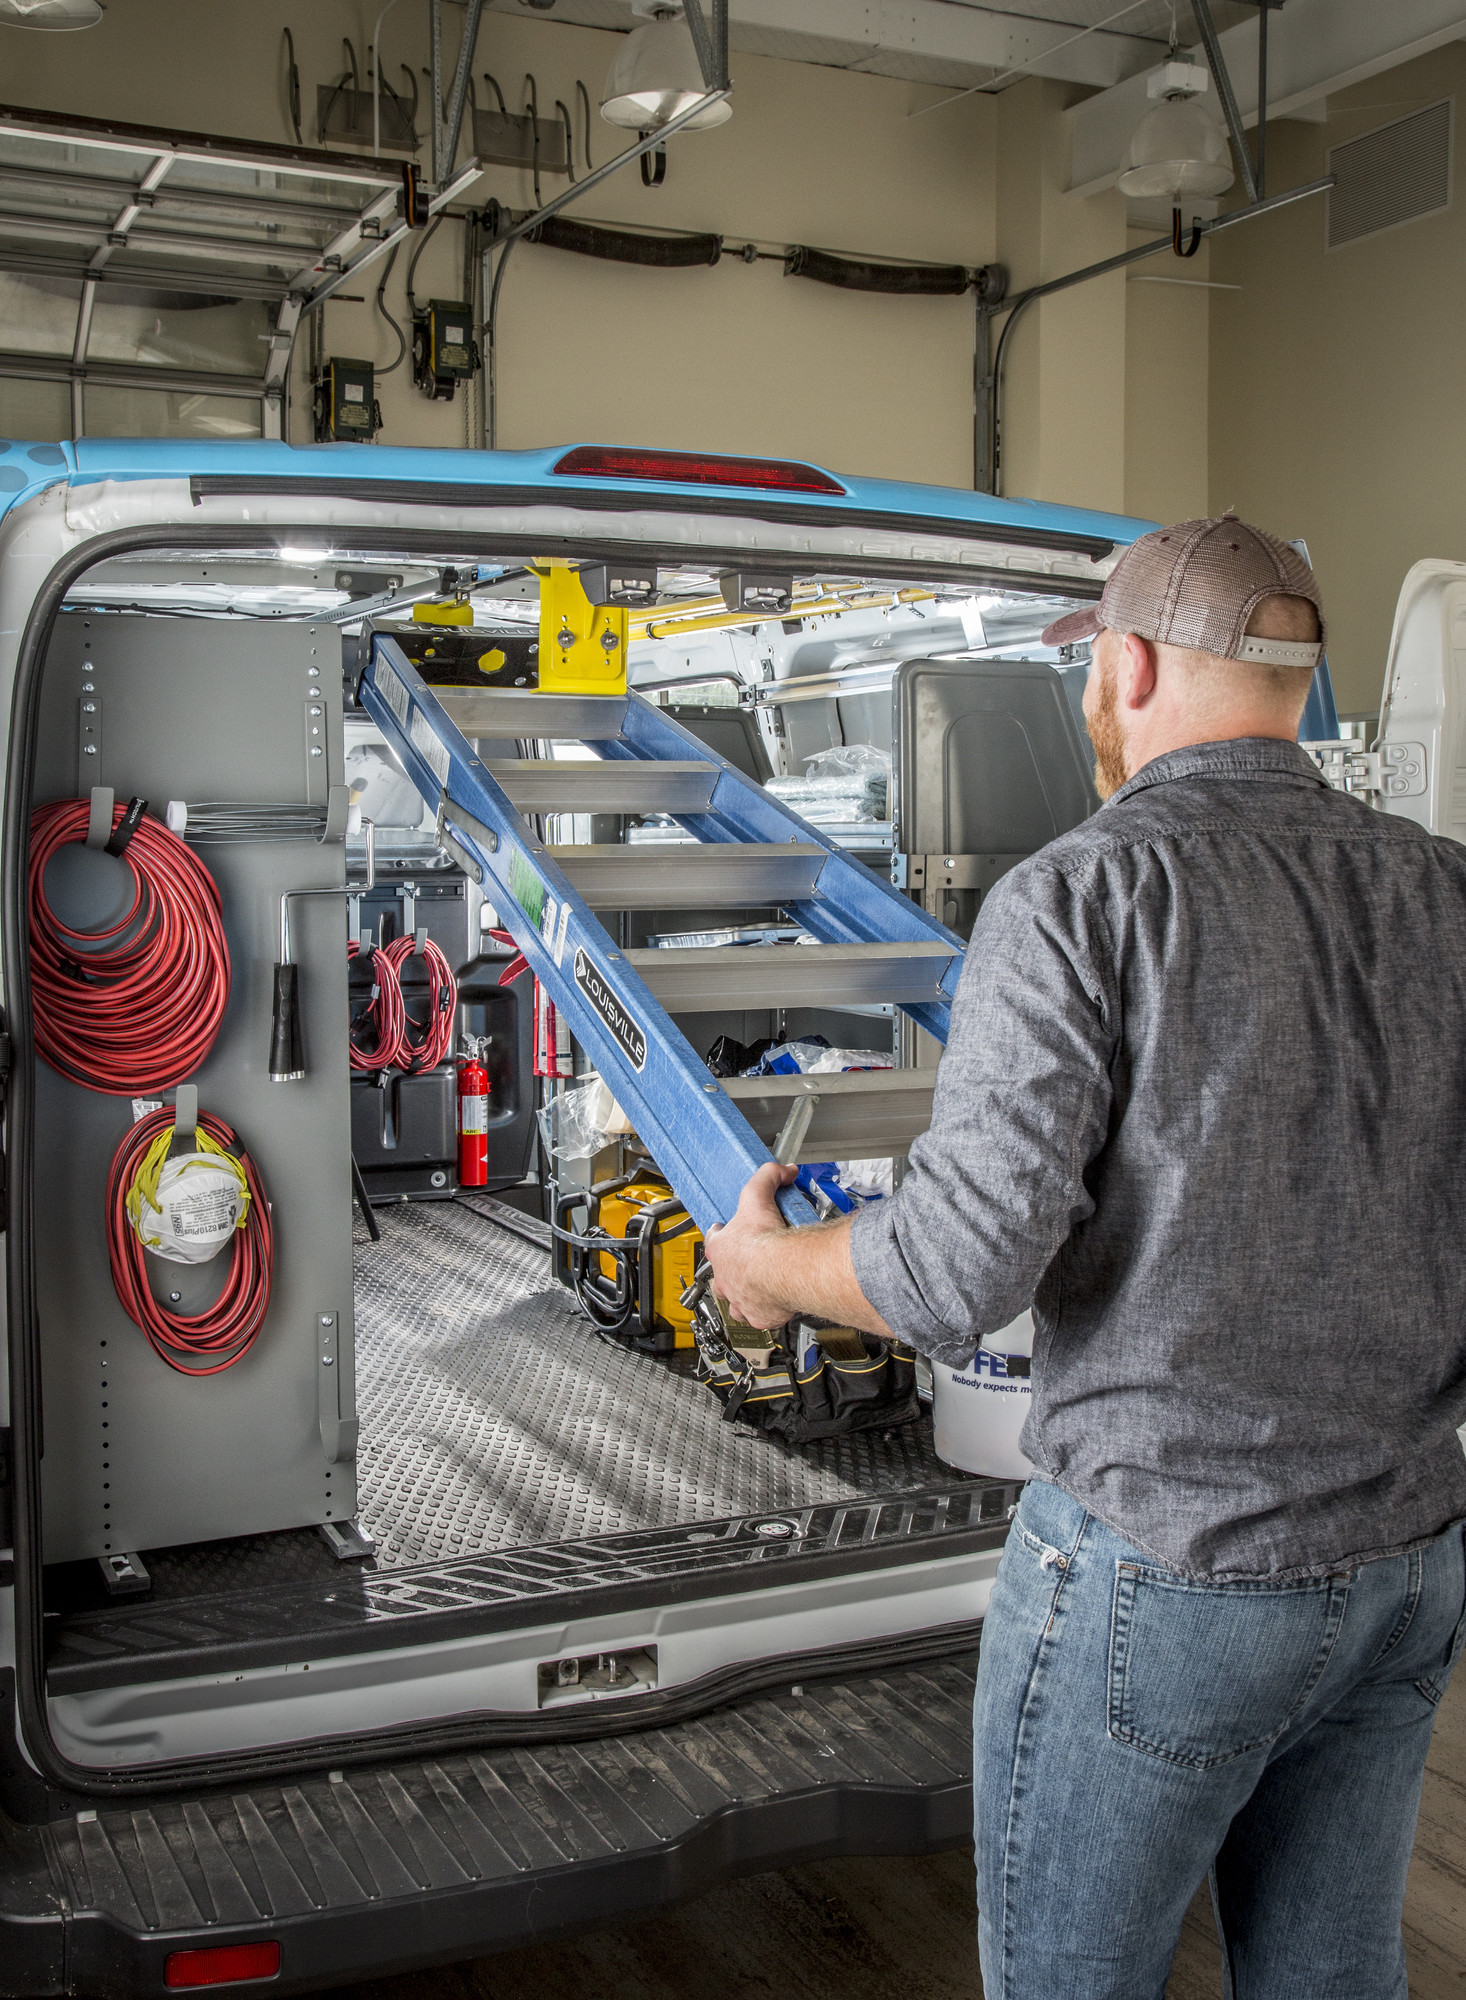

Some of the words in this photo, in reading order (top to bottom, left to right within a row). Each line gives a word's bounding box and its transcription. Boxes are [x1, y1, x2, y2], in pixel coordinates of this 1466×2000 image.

[585, 969, 644, 1063] LOUISVILLE
[172, 1216, 183, 1234] N95
[218, 1221, 229, 1231] 3M
[952, 1374, 981, 1390] Nobody
[983, 1382, 1018, 1393] expects
